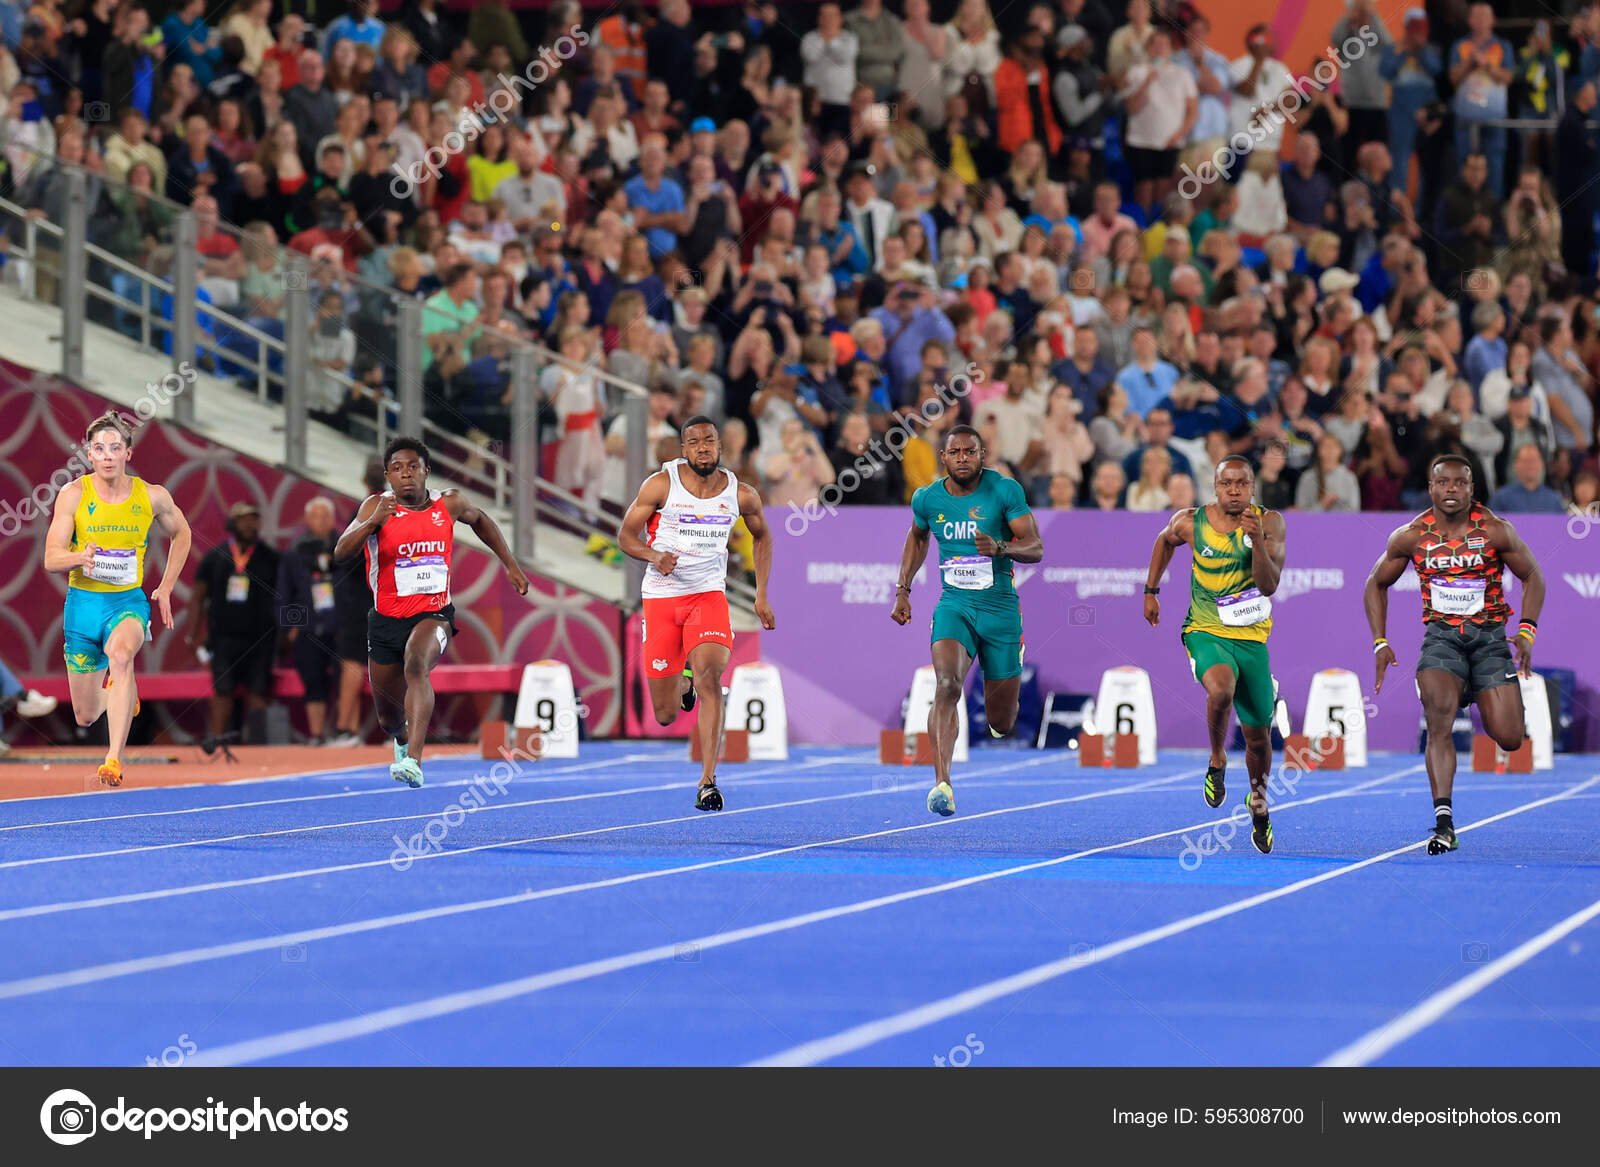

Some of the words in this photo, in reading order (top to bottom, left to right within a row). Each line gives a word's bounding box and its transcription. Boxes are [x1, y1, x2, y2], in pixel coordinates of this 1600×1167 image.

[943, 521, 977, 539] CMR
[398, 541, 446, 557] cymru
[1425, 554, 1484, 569] KENYA
[807, 562, 926, 584] BIRMINGHM
[843, 582, 890, 604] 2022
[1077, 583, 1135, 599] games
[1233, 604, 1261, 617] SIMBINE
[537, 699, 555, 734] 9
[746, 699, 764, 734] 8
[1116, 703, 1135, 734] 6
[1329, 706, 1345, 736] 5
